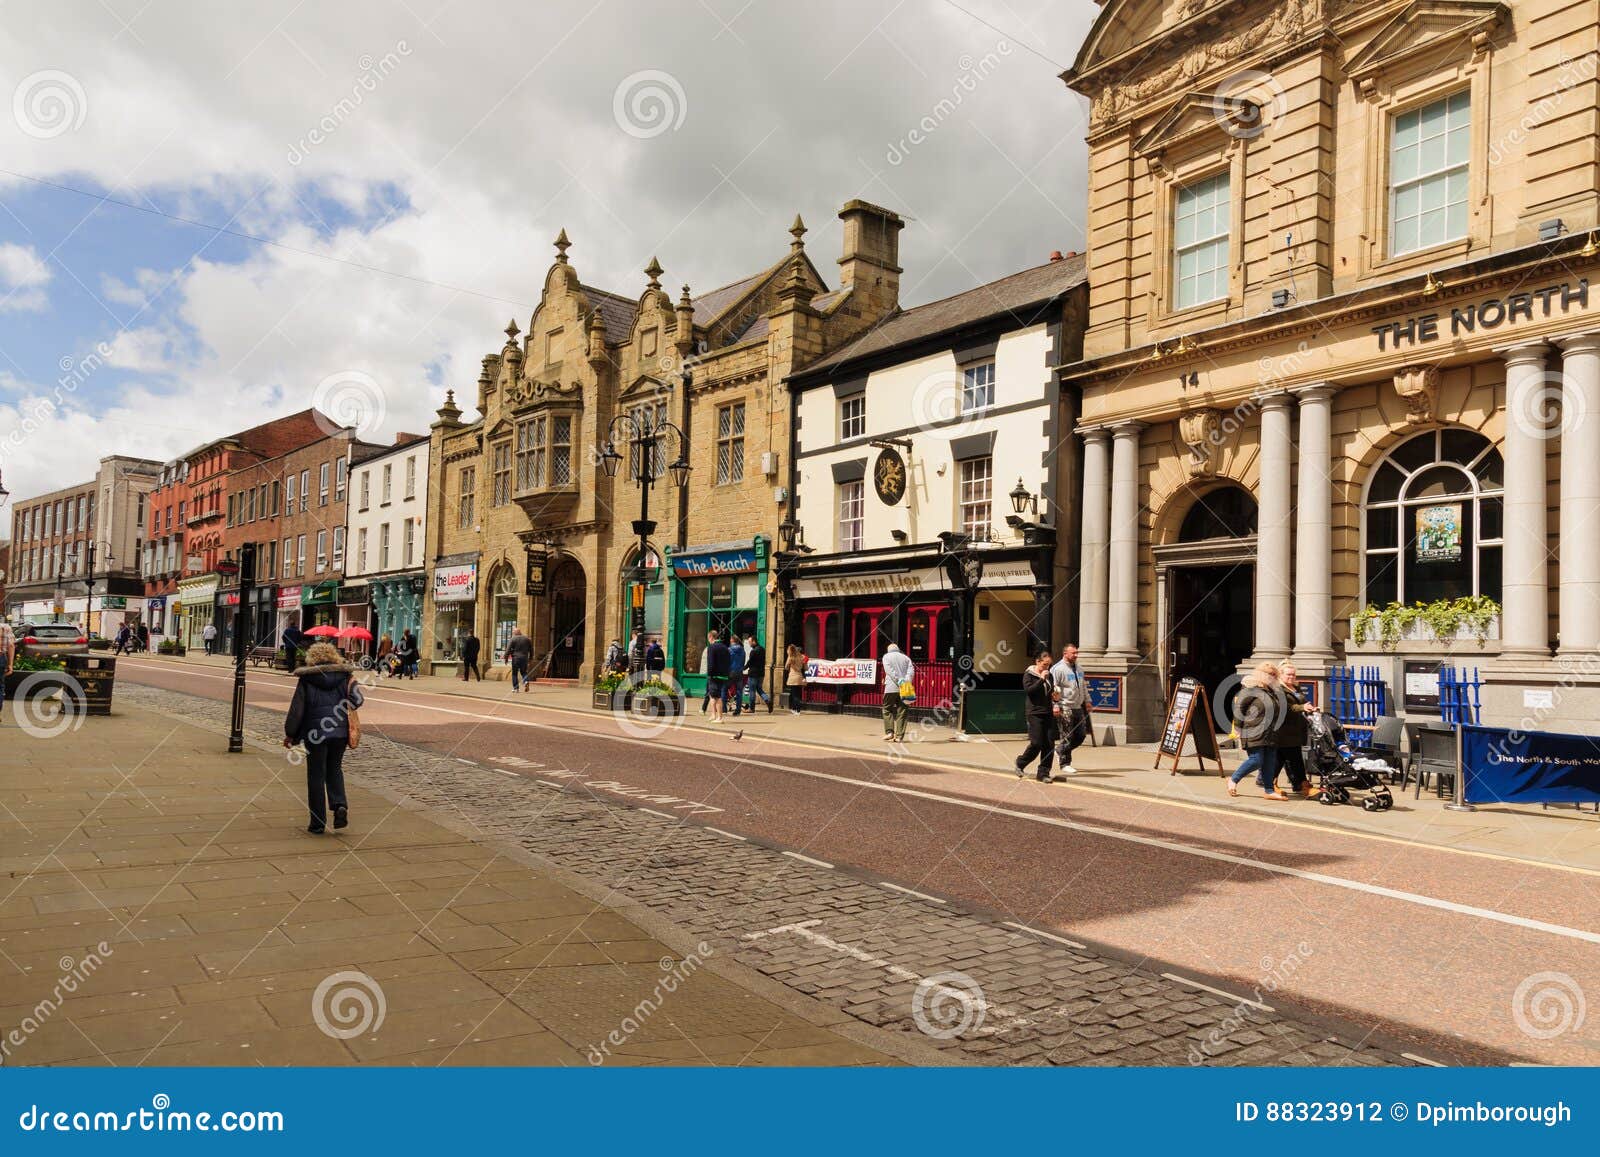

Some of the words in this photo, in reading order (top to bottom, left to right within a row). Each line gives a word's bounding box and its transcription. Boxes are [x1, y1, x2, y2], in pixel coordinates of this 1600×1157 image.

[1371, 312, 1439, 352] THE
[1451, 278, 1589, 336] NORTH
[1180, 371, 1199, 391] 14
[683, 558, 708, 574] The
[710, 554, 750, 573] Beach
[436, 572, 447, 587] the
[447, 570, 470, 587] Leader
[818, 664, 855, 677] SPORTS
[857, 663, 872, 671] LIVE
[857, 671, 872, 679] HERE
[1497, 754, 1514, 763] The
[1516, 755, 1543, 764] North
[1545, 756, 1552, 764] &
[1554, 757, 1581, 766] South
